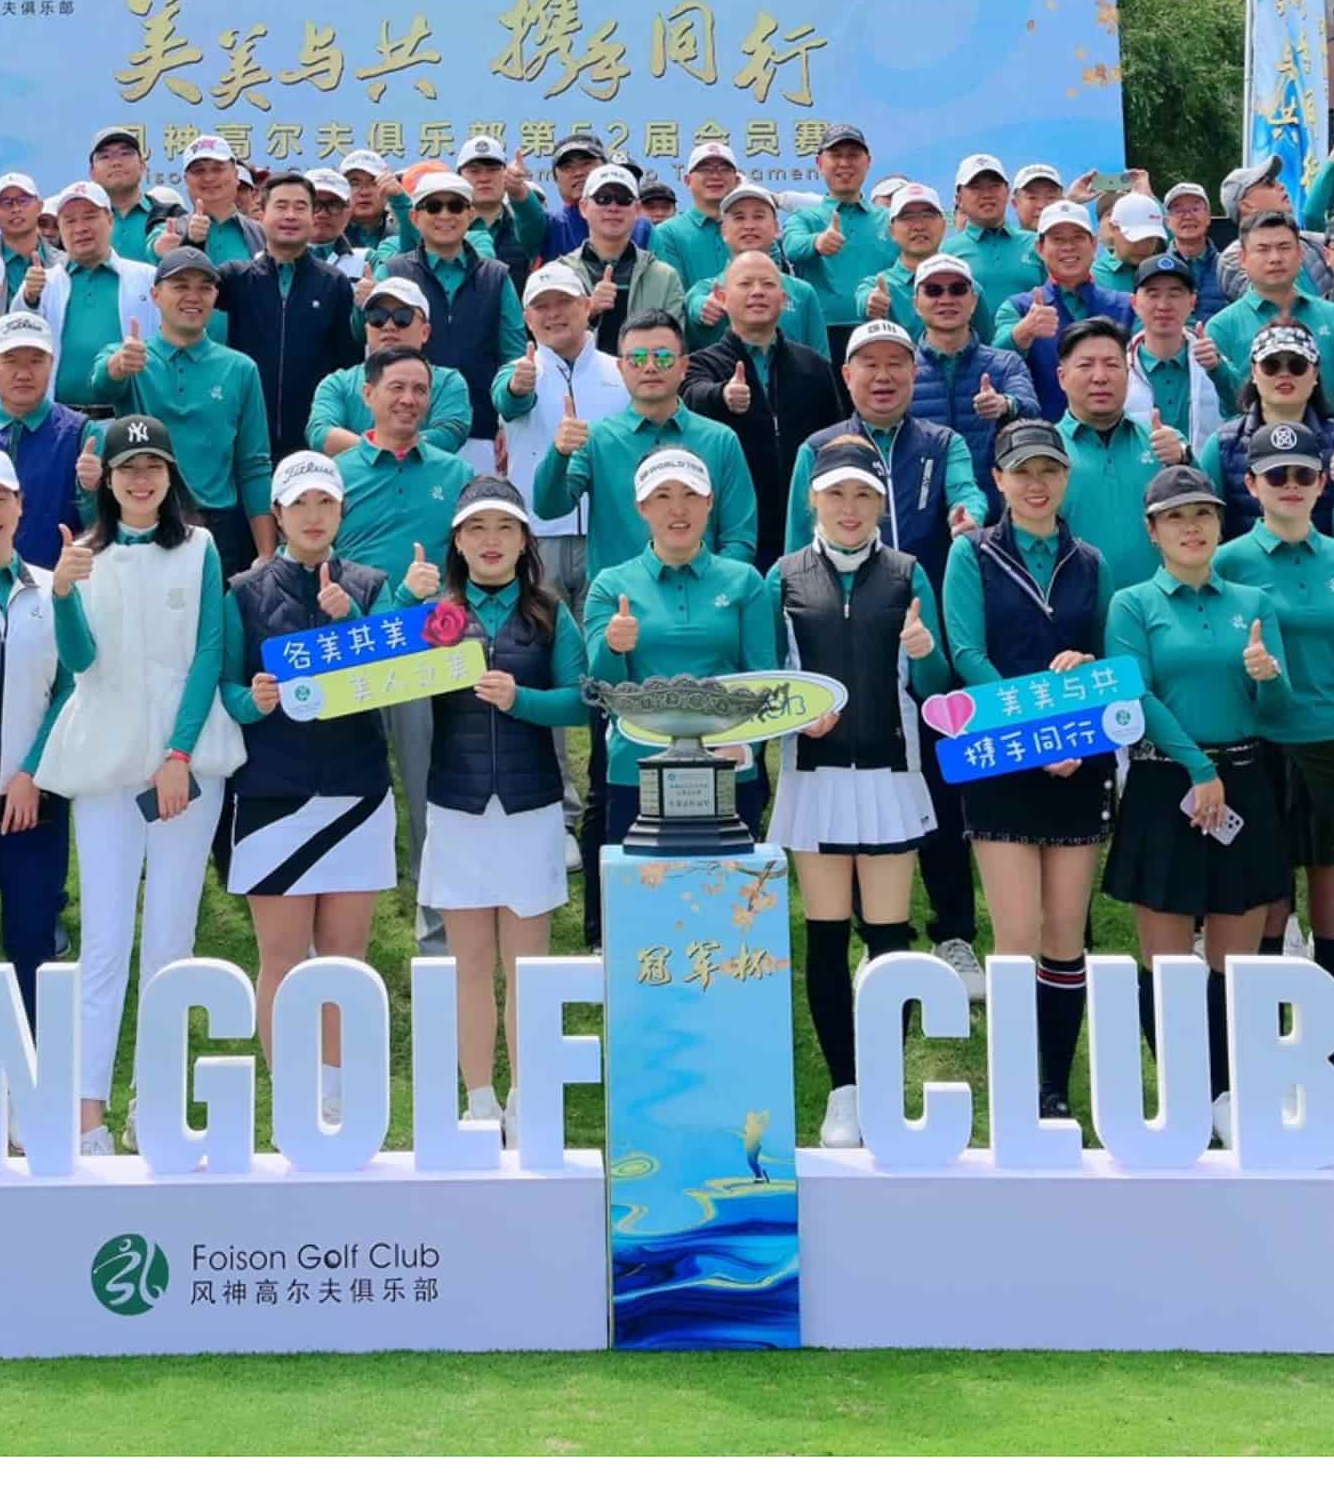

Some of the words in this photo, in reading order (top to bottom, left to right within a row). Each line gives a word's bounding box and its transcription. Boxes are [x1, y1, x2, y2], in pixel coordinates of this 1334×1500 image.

[128, 421, 149, 443] NY
[282, 617, 408, 670] 各美其美
[351, 651, 469, 702] 美人之美
[995, 666, 1119, 717] 美美与共
[963, 719, 1099, 770] 携手同行
[636, 940, 774, 987] 冠军杯
[137, 956, 604, 1173] GOLF
[193, 1244, 286, 1271] Foison
[297, 1243, 360, 1270] Golf
[369, 1242, 440, 1269] Club
[190, 1277, 440, 1307] 风神高尔夫俱乐部
